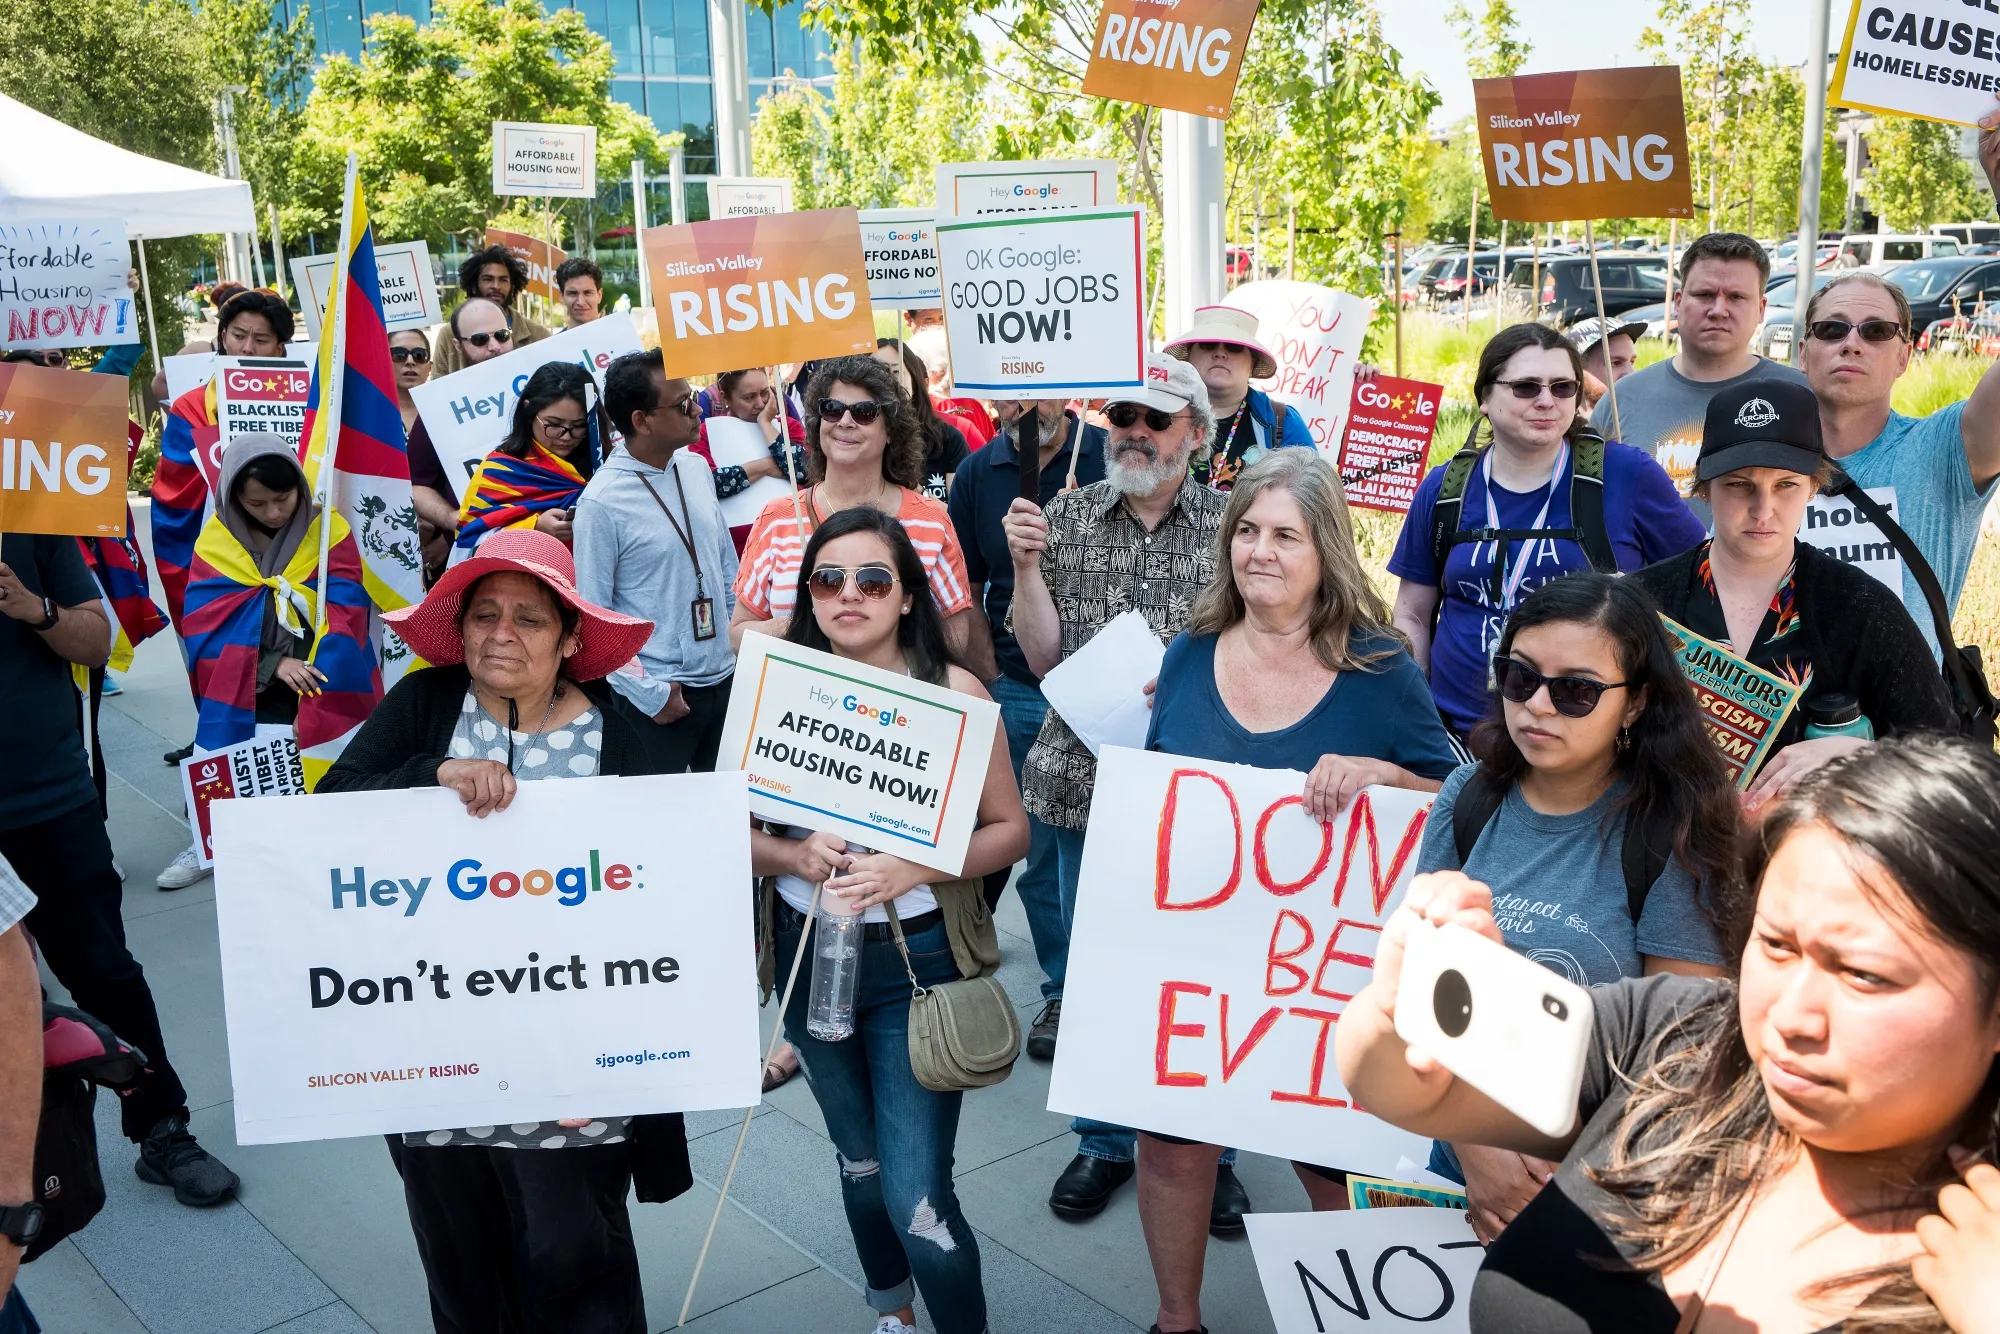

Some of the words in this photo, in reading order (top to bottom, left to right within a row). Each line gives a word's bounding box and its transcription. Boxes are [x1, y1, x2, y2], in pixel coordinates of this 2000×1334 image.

[1099, 14, 1232, 77] RISING
[1867, 7, 2000, 64] CAUSE
[1490, 115, 1532, 128] Silicon
[1534, 111, 1581, 128] Valley
[515, 150, 575, 161] AFFORDABLE
[1492, 134, 1673, 187] RISING
[508, 163, 553, 173] HOUSING
[555, 166, 581, 175] NOW!
[990, 186, 1011, 200] Hey
[1013, 183, 1061, 198] Google:
[728, 206, 776, 215] AFFORDABLE
[867, 232, 885, 244] Hey
[665, 262, 715, 278] Silicon
[715, 254, 763, 271] Valley
[864, 248, 937, 262] FFORDABL
[966, 248, 994, 271] OK
[998, 244, 1082, 272] Google:
[866, 268, 910, 280] USING
[914, 267, 938, 278] NO
[0, 276, 92, 309] Housing
[382, 291, 418, 305] NOW!
[951, 279, 1025, 309] GOOD
[1035, 273, 1120, 305] JOBS
[669, 273, 856, 339] RISING
[1285, 296, 1342, 332] YOU
[8, 298, 130, 342] NOW!
[977, 309, 1072, 344] NOW!
[1269, 332, 1345, 373] DON'T
[1001, 361, 1045, 375] RISING
[450, 391, 505, 425] Hey
[229, 420, 268, 432] FREE
[271, 421, 303, 433] TIBE
[1353, 414, 1369, 425] Stop
[1369, 417, 1393, 428] Google
[1393, 421, 1429, 434] Censorship
[1347, 443, 1386, 456] PEACEFUL
[1349, 429, 1427, 452] DEMOCRACY
[1378, 485, 1414, 501] LAMA
[1380, 473, 1418, 487] RIGHTS
[1345, 492, 1363, 503] OBEL
[1364, 495, 1389, 506] PEACE
[1685, 645, 1788, 708] JANITORS
[809, 685, 839, 710] Hey
[842, 695, 912, 729] Google:
[1747, 699, 1778, 718] OUT
[778, 711, 930, 771] AFFORDABLE
[252, 746, 275, 795] TIBET
[270, 739, 289, 788] RIGHTS
[754, 736, 863, 785] HOUSING
[868, 770, 939, 809] NOW!
[868, 811, 931, 837] sjgoogle.com
[330, 866, 432, 917] Hey
[446, 849, 645, 907] Google:
[1490, 893, 1562, 920] otaract
[1500, 909, 1518, 918] CLUB
[1518, 911, 1528, 919] OF
[1492, 911, 1536, 934] avis
[1264, 908, 1384, 1002] BE
[466, 951, 588, 997] evict
[603, 956, 681, 987] me
[595, 1049, 691, 1068] sjgoogle.com
[1154, 980, 1368, 1113] EVI
[307, 1071, 368, 1088] SILICON
[369, 1066, 425, 1083] VALLEY
[428, 1062, 480, 1078] RISING
